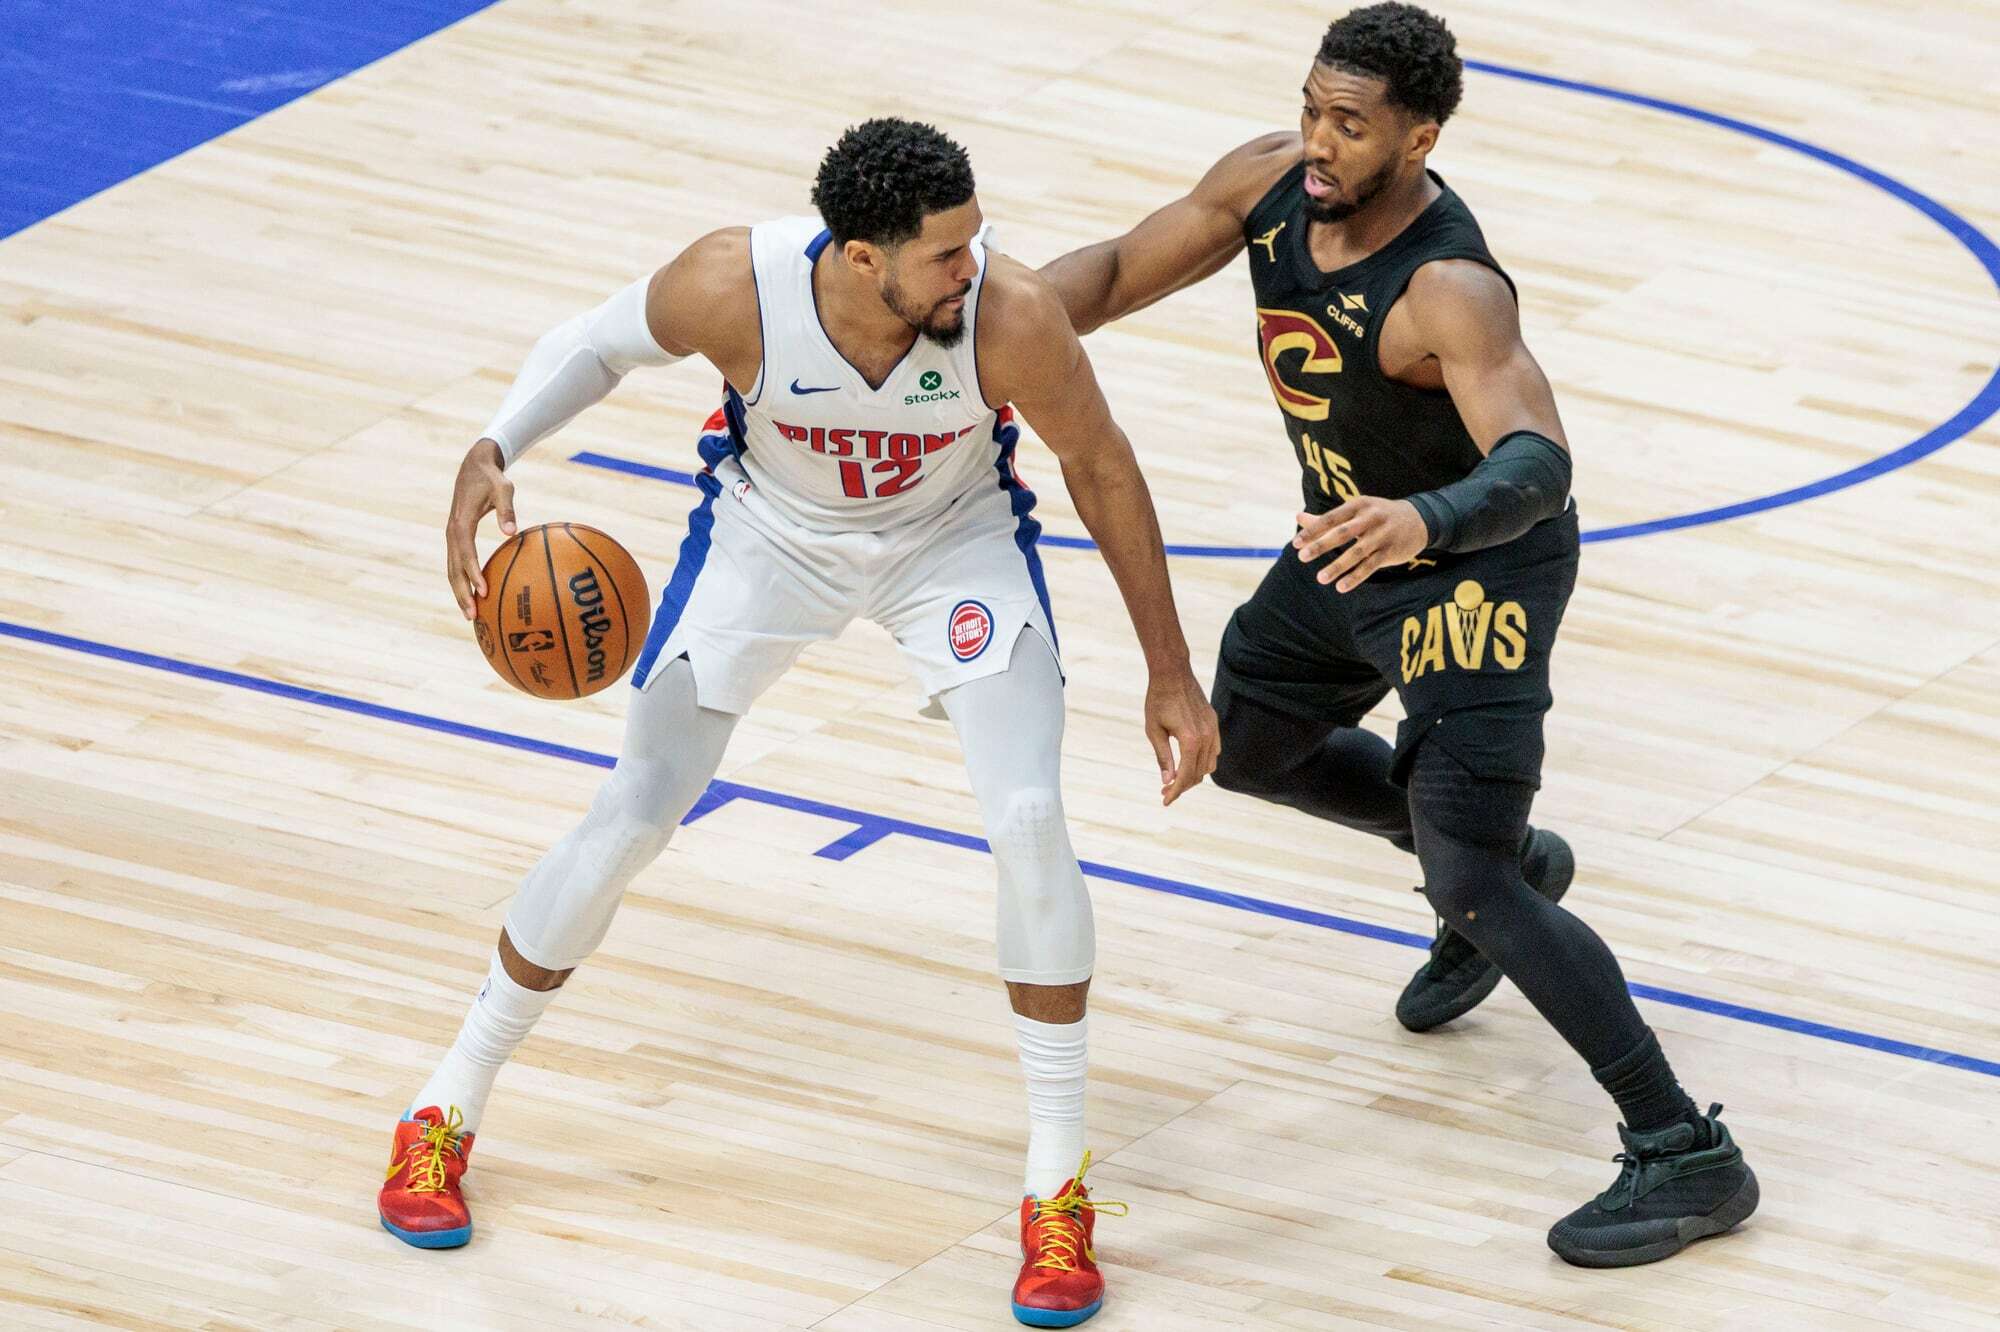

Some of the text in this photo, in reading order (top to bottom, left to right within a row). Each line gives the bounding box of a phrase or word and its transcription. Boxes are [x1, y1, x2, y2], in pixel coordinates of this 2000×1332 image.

[1326, 304, 1365, 339] CLIFFS
[1256, 307, 1344, 422] C
[904, 389, 961, 406] StockX
[772, 419, 978, 460] PISTON
[838, 458, 926, 499] 12
[569, 566, 612, 683] Wilson
[1400, 601, 1528, 685] CAVS
